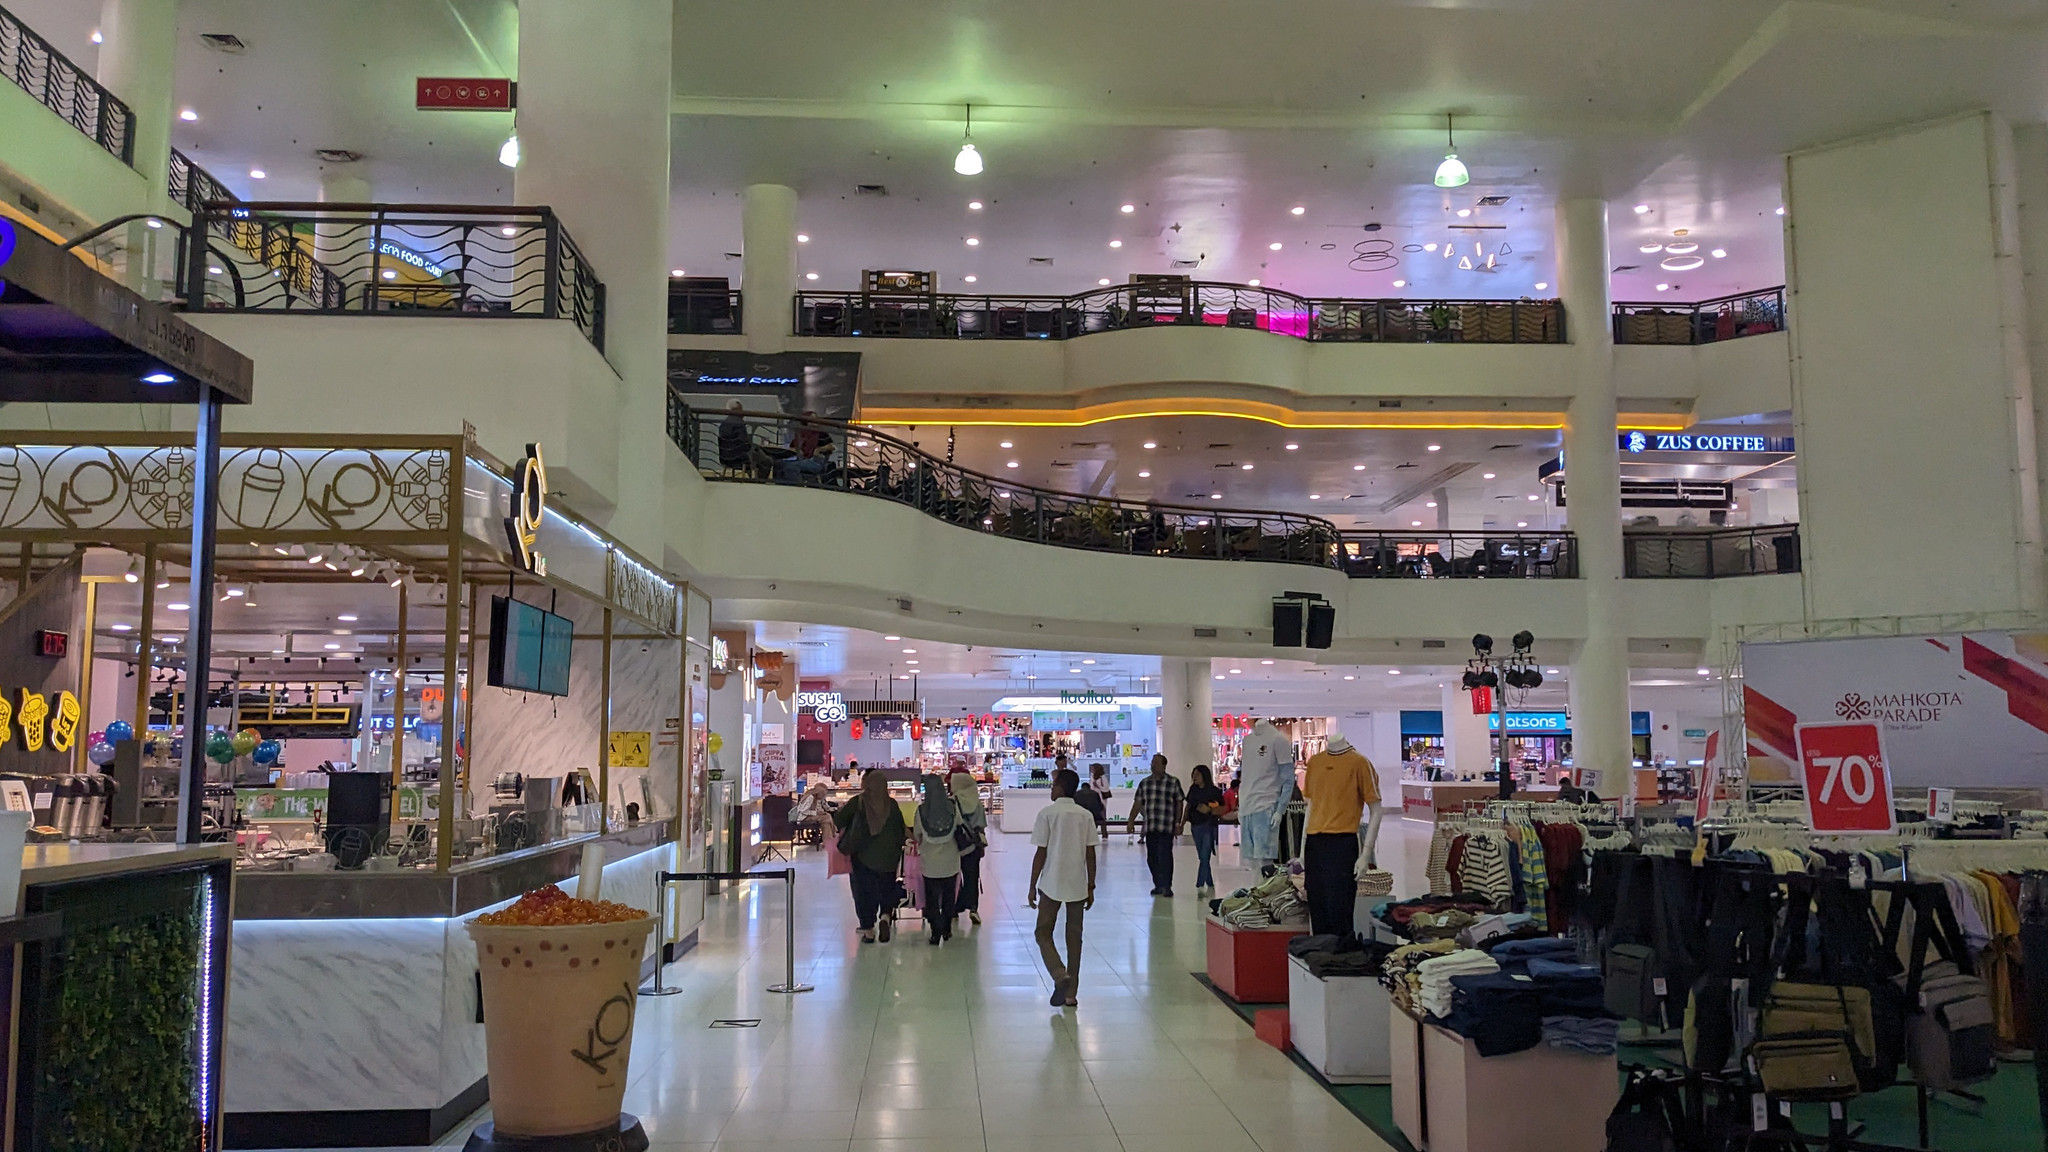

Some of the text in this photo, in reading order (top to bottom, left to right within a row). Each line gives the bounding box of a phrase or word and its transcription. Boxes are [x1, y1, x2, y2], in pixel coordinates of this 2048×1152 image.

[401, 250, 424, 267] FOOD
[749, 375, 800, 385] Recipe
[1656, 435, 1765, 451] ZUS COFFEE
[797, 691, 842, 707] SUSHI
[1873, 692, 1962, 707] MAHKOTA
[815, 704, 847, 722] GO!
[1873, 708, 1942, 722] PARADE
[632, 743, 642, 753] A
[282, 795, 309, 814] THE
